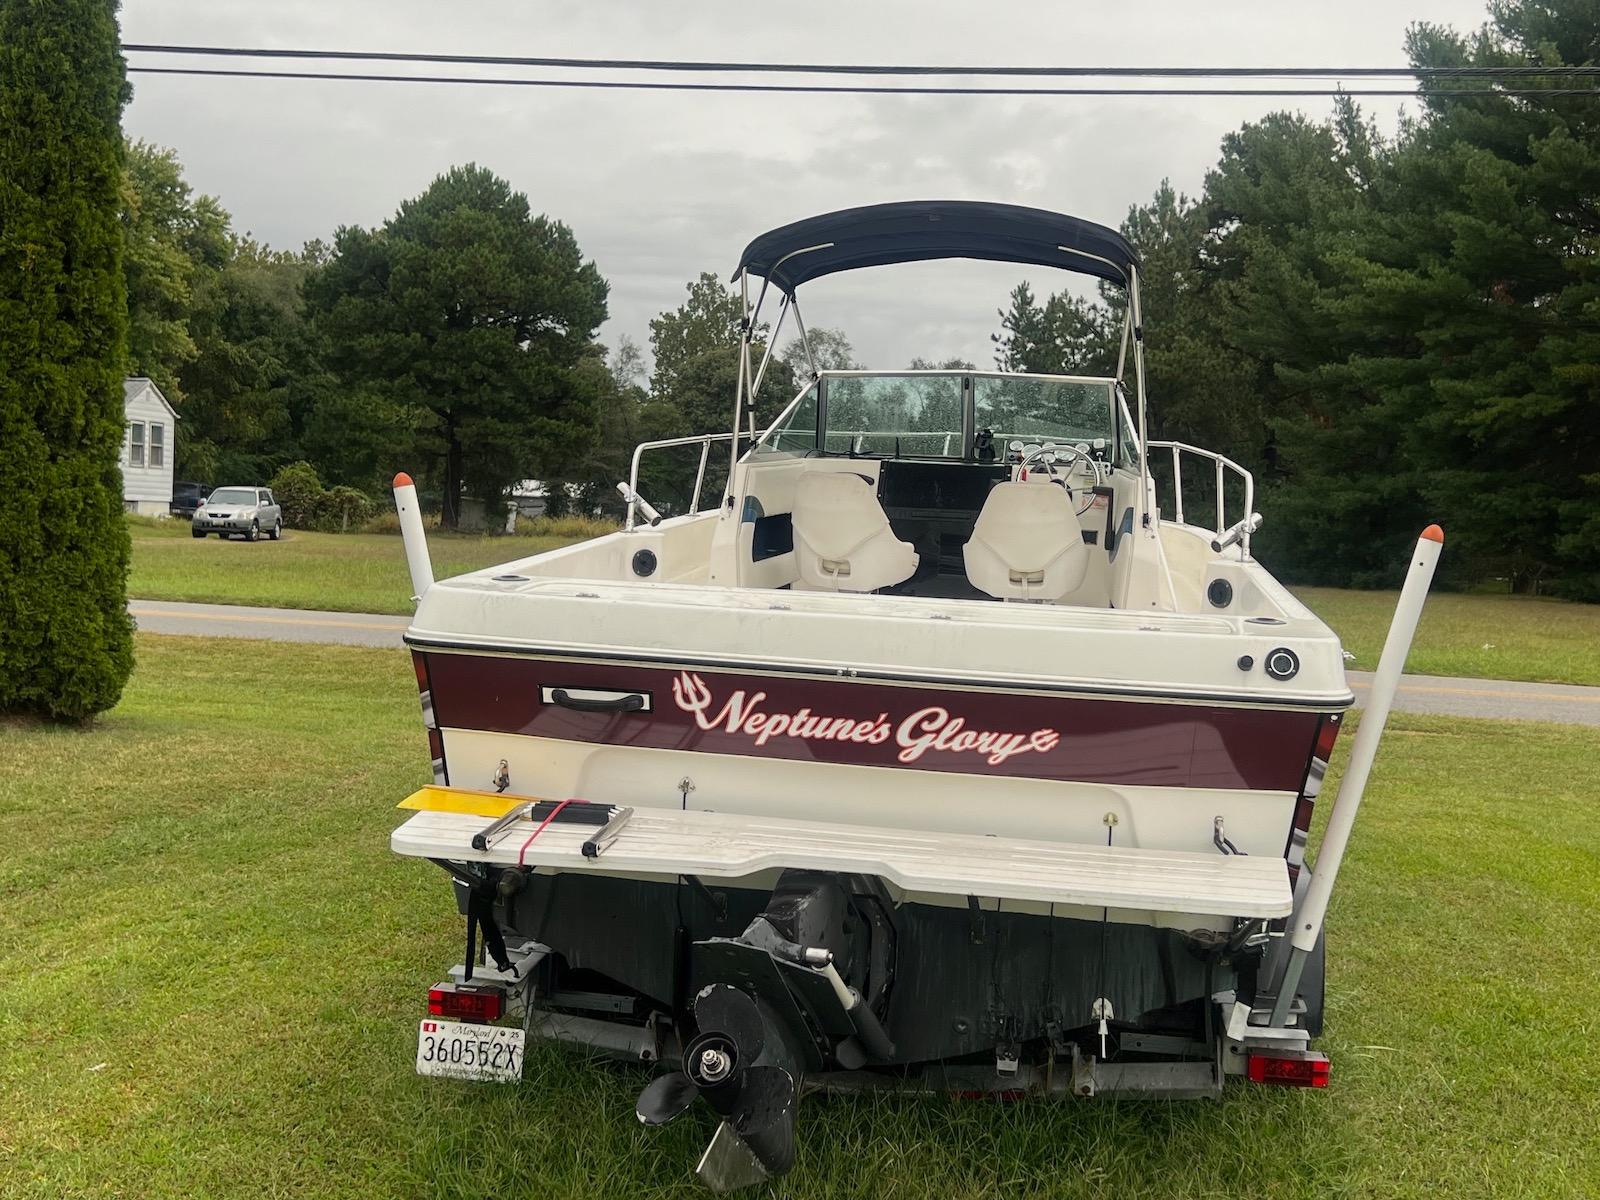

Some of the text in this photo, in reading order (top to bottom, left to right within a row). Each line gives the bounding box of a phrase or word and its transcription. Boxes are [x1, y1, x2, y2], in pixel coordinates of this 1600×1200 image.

[714, 690, 1029, 765] Neptune's Glory
[451, 1025, 492, 1039] Maryland
[423, 1036, 517, 1070] 360552X
